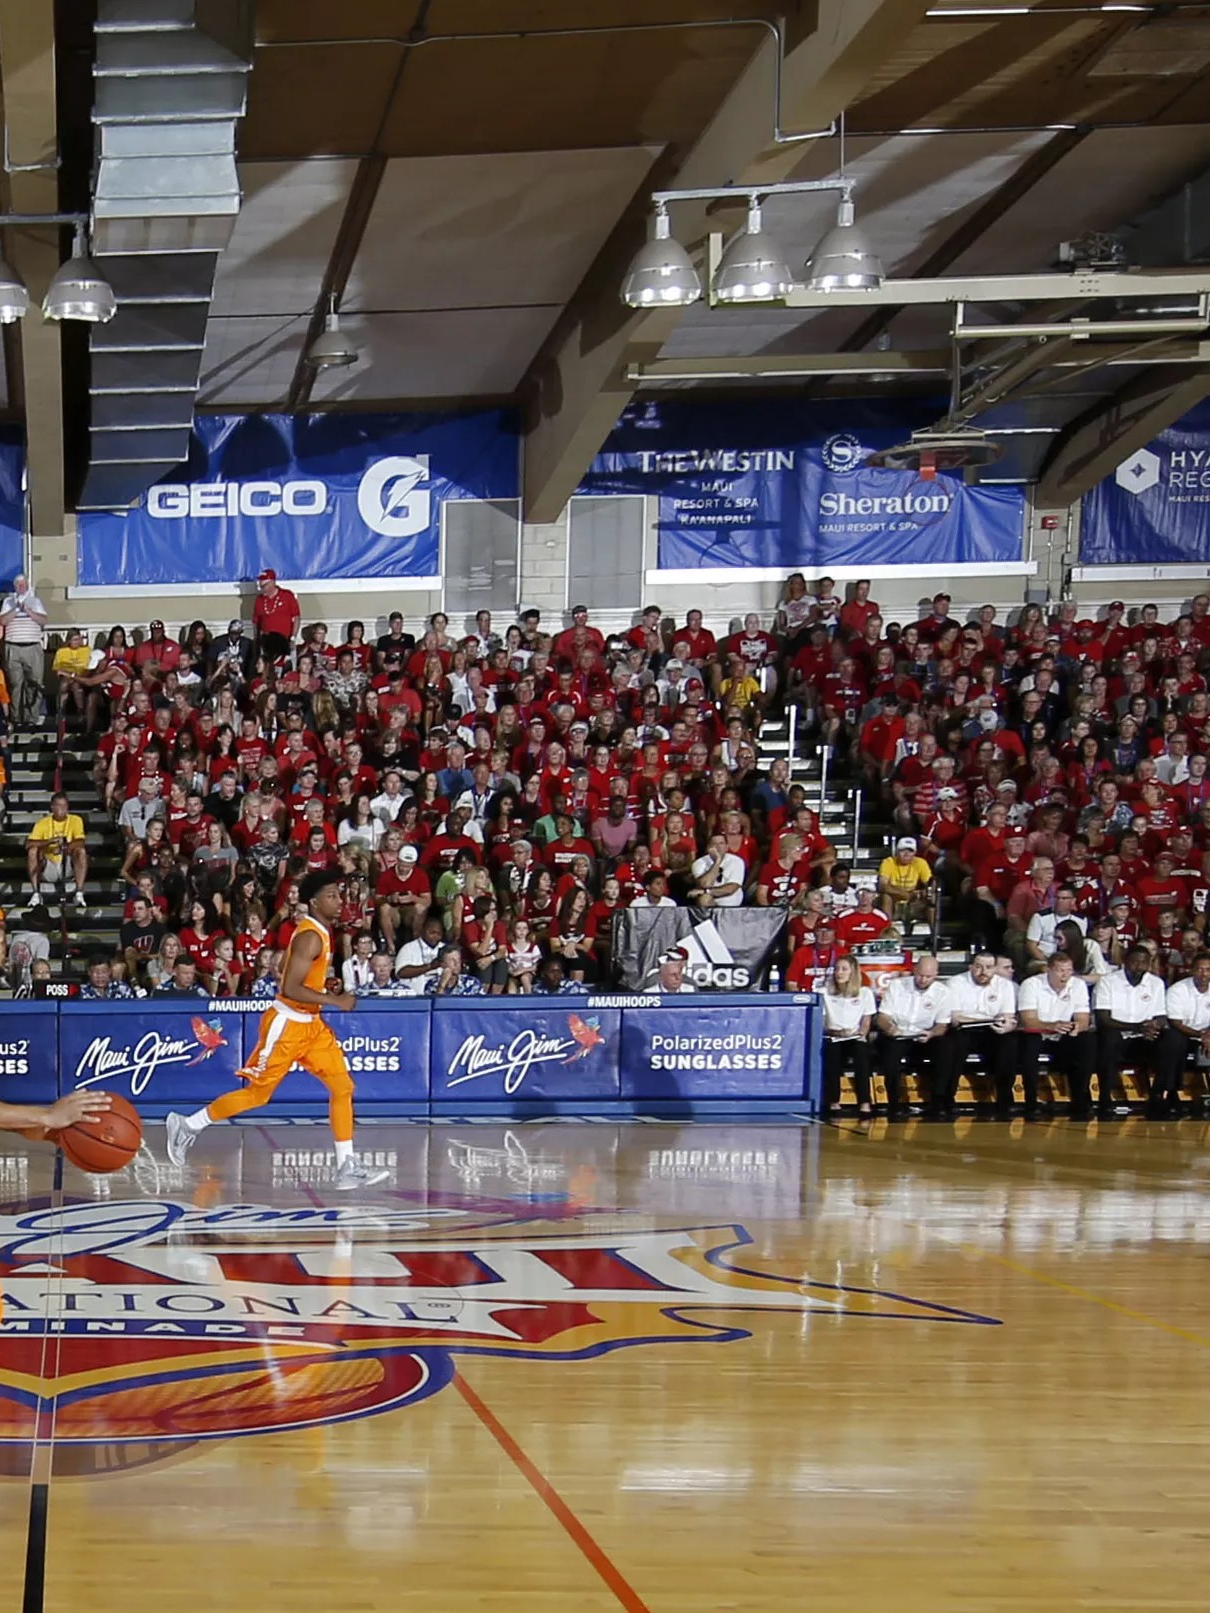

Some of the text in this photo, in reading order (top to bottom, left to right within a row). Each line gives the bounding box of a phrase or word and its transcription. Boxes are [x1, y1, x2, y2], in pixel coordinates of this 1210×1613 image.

[637, 448, 796, 474] THE WESTIN
[147, 480, 327, 519] GEICO
[357, 453, 431, 538] G
[673, 499, 720, 510] RESORT
[734, 497, 760, 508] SPA
[819, 492, 951, 516] Sheraton
[819, 524, 846, 534] MAUI
[846, 522, 886, 533] RESORT
[898, 520, 919, 531] SPA
[46, 984, 69, 996] POSS
[208, 1000, 276, 1012] #MAUIHOOP
[587, 996, 662, 1008] #MAUIHOOPS
[651, 1035, 783, 1051] PolarizedPlus2
[75, 1031, 199, 1095] Maui Jim
[448, 1029, 576, 1094] Maui Jim
[650, 1054, 782, 1071] SUNGLASSES
